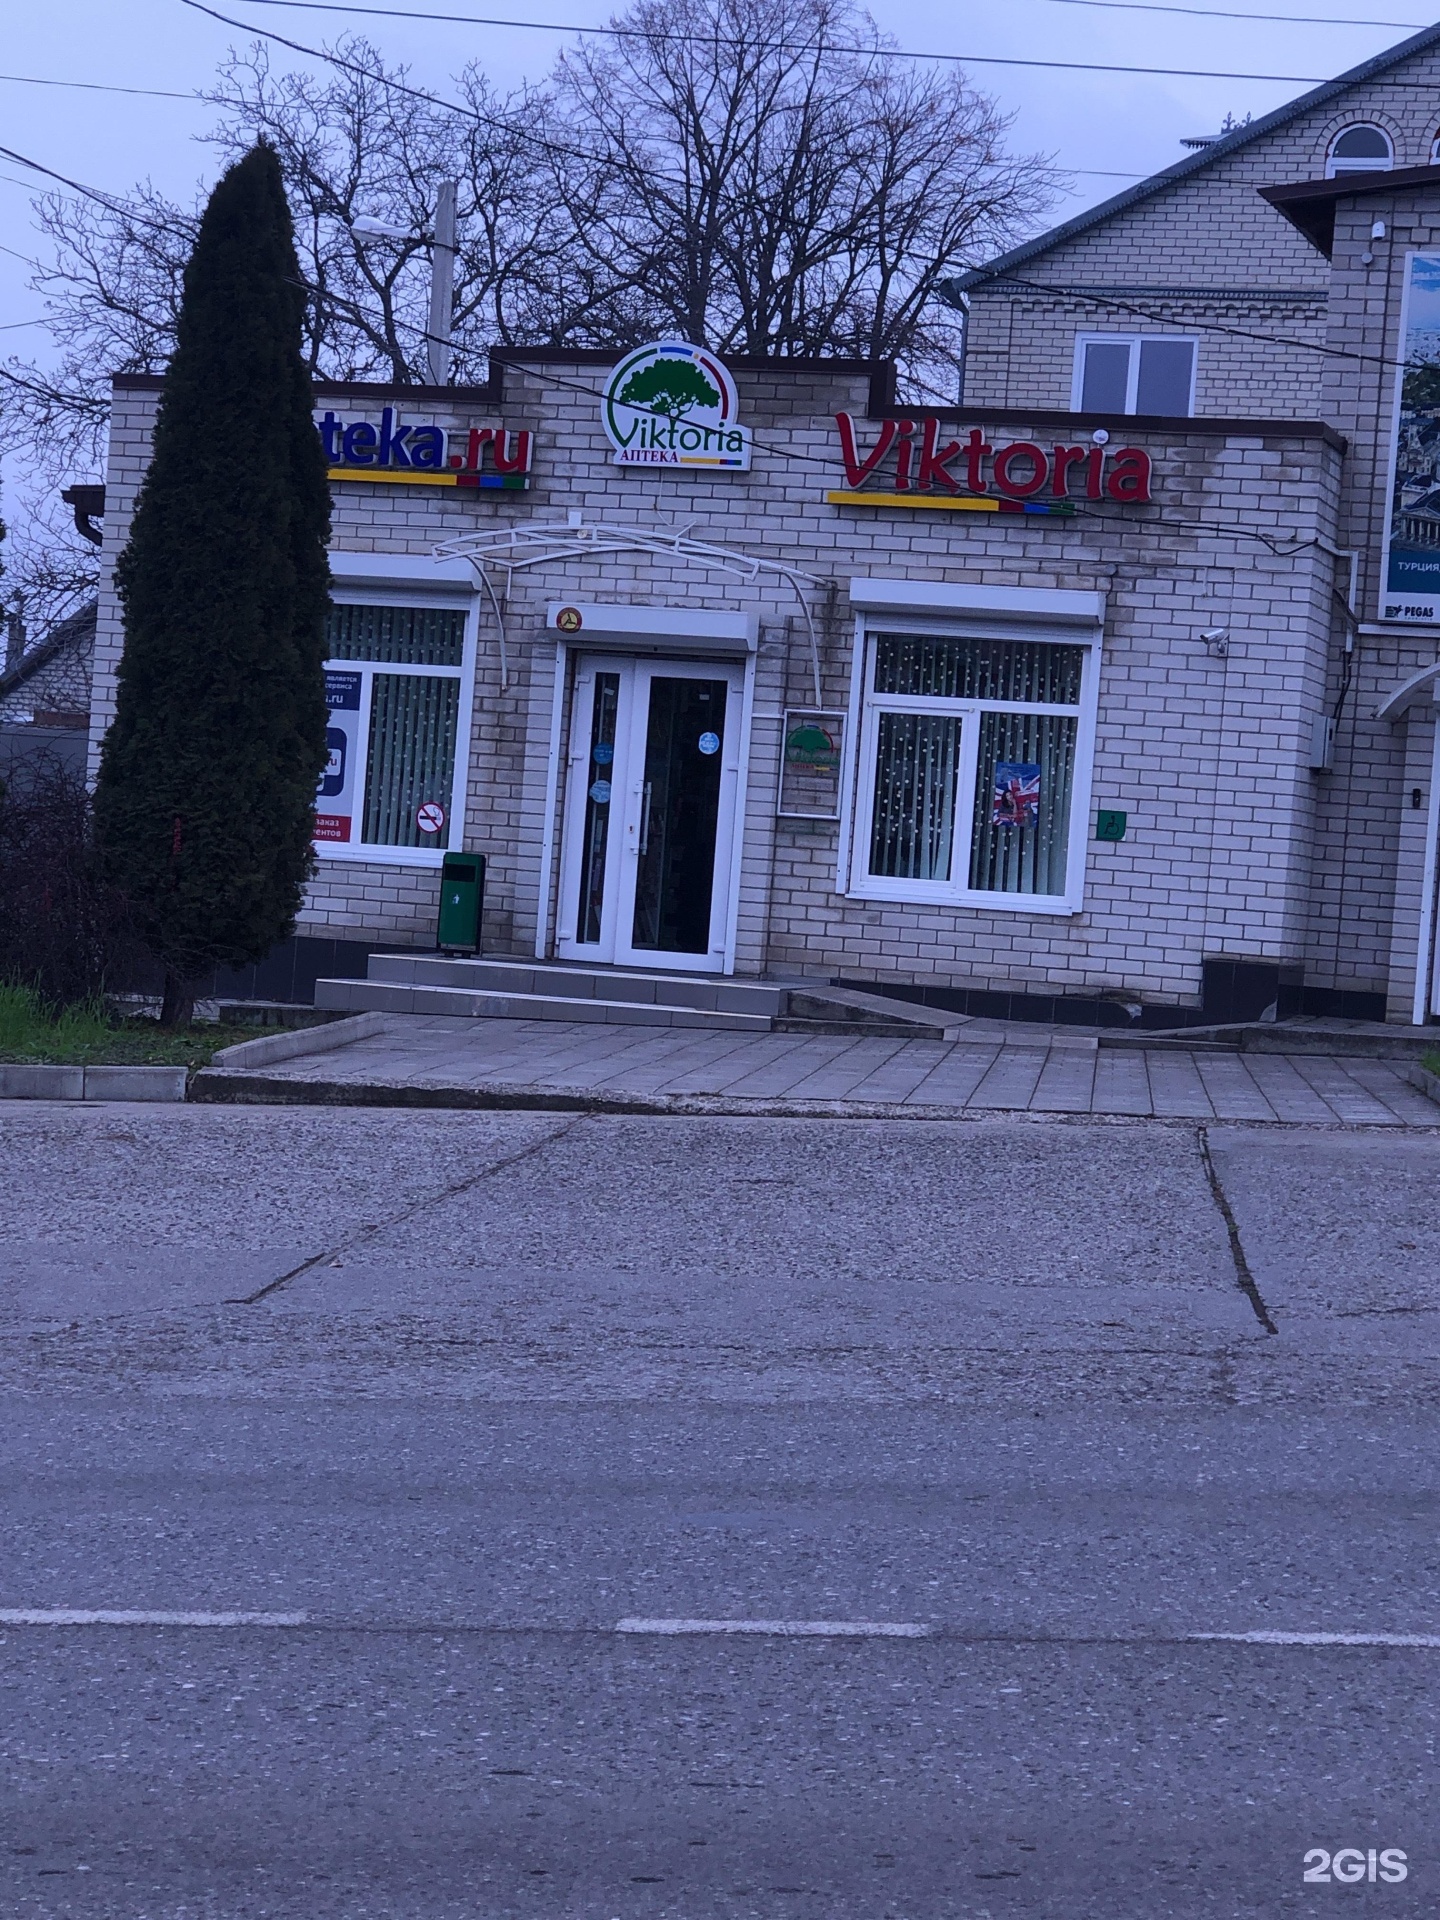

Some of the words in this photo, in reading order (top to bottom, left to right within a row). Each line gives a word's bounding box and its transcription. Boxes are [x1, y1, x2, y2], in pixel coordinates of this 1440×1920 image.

[316, 407, 534, 472] teka.ru
[606, 417, 743, 452] Viktoria
[619, 449, 679, 463] АПТЕКА
[835, 411, 1152, 501] Viktoria
[1404, 606, 1434, 617] PEGAS
[315, 818, 340, 828] заказ
